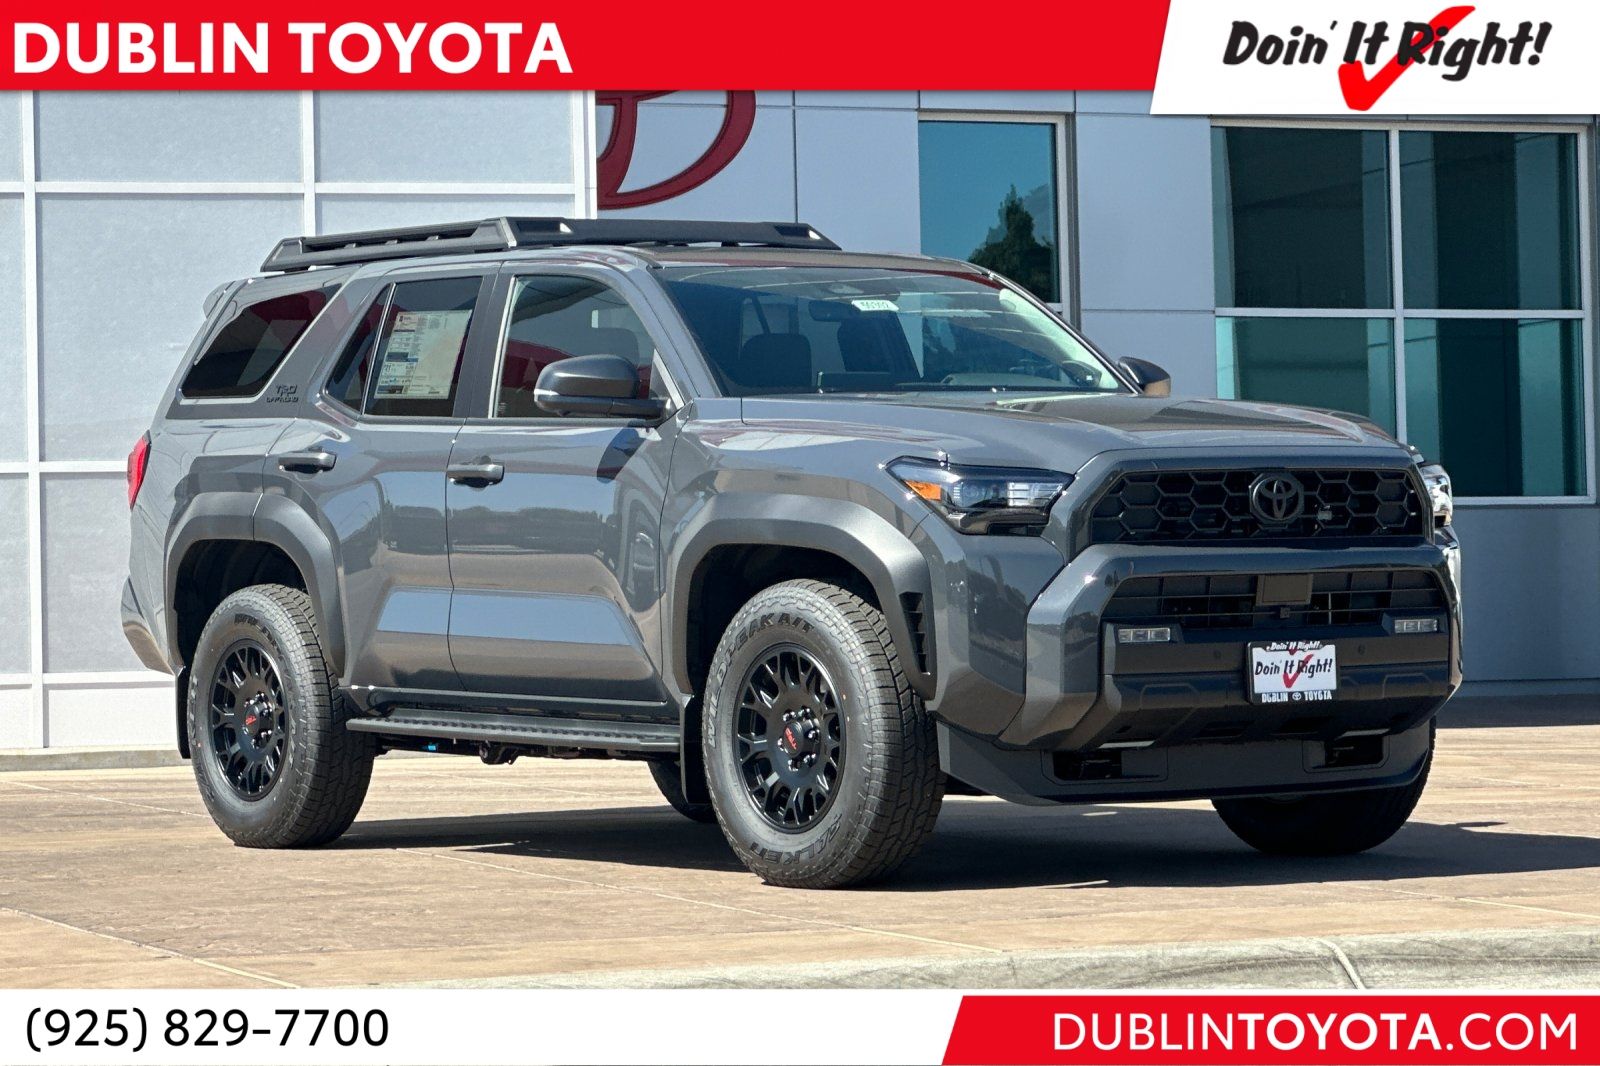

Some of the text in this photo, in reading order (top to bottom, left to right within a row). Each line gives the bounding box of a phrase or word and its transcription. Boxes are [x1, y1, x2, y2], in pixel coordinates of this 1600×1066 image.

[1283, 659, 1296, 674] It
[1297, 658, 1333, 679] Right!
[1261, 689, 1333, 704] DUBLIN TOYOTA
